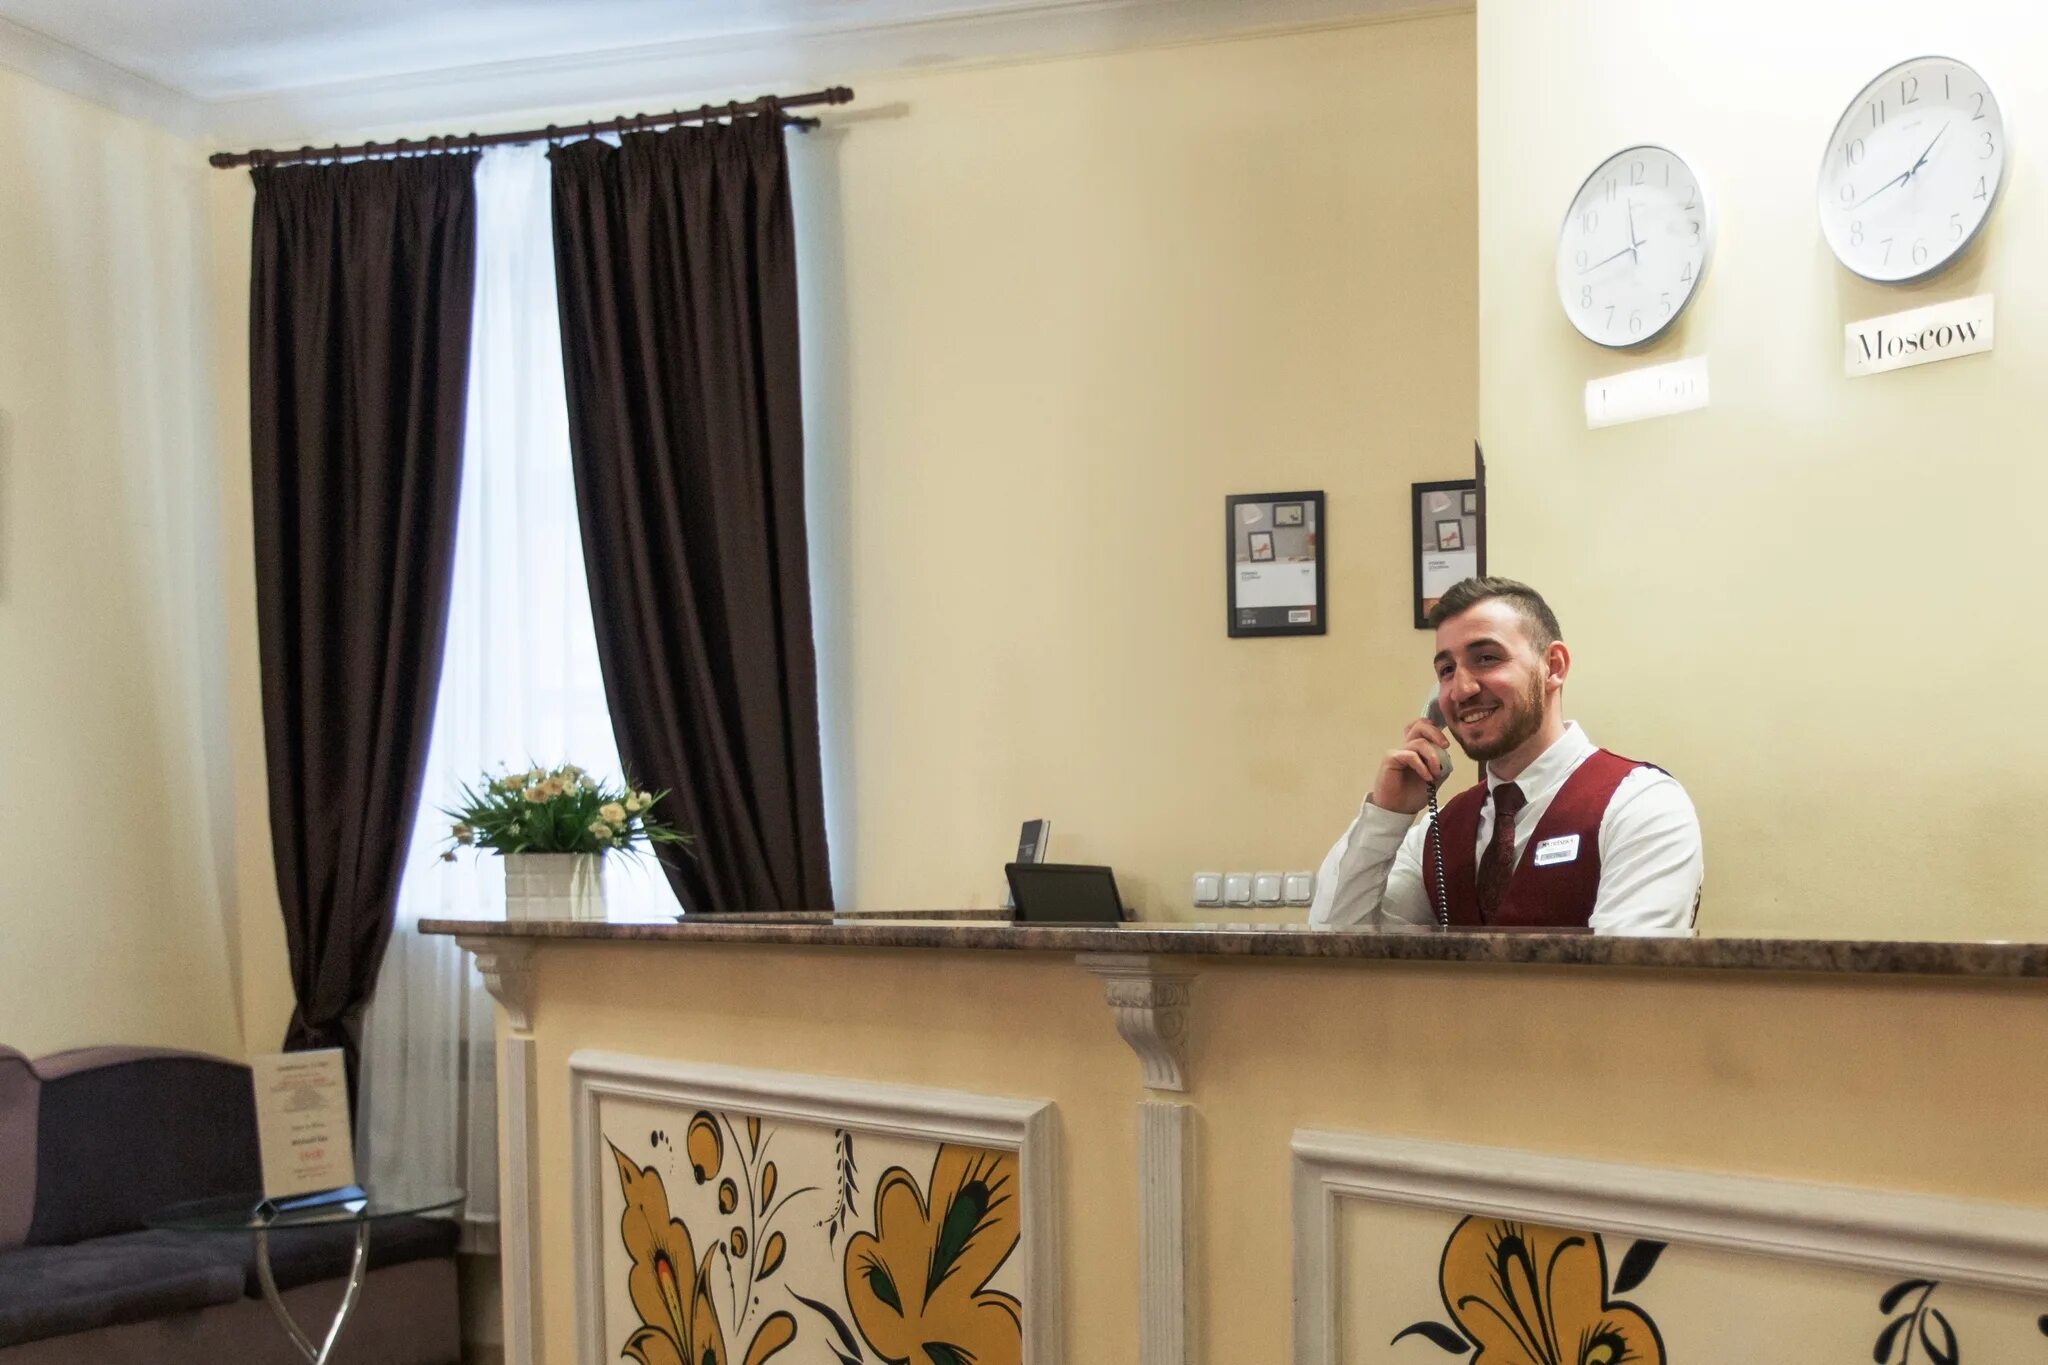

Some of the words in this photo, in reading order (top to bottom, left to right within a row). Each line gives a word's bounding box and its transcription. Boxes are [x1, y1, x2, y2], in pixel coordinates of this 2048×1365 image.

[1901, 76, 1919, 106] 12
[1945, 74, 1950, 100] 1
[1871, 99, 1885, 128] 11
[1970, 92, 1985, 121] 2
[1845, 138, 1865, 168] 10
[1979, 131, 1994, 160] 3
[1630, 161, 1645, 187] 12
[1665, 163, 1670, 188] 1
[1606, 178, 1617, 203] 11
[1684, 185, 1696, 210] 2
[1840, 182, 1855, 212] 9
[1972, 175, 1987, 201] 4
[1582, 210, 1599, 235] 10
[1688, 220, 1700, 247] 3
[1850, 220, 1864, 248] 8
[1949, 213, 1963, 242] 5
[1880, 238, 1893, 266] 7
[1912, 238, 1928, 266] 6
[1680, 261, 1692, 285] 4
[1581, 285, 1593, 310] 8
[1660, 292, 1671, 317] 5
[1605, 305, 1615, 330] 7
[1629, 309, 1642, 334] 6
[1858, 319, 1982, 364] Moscow
